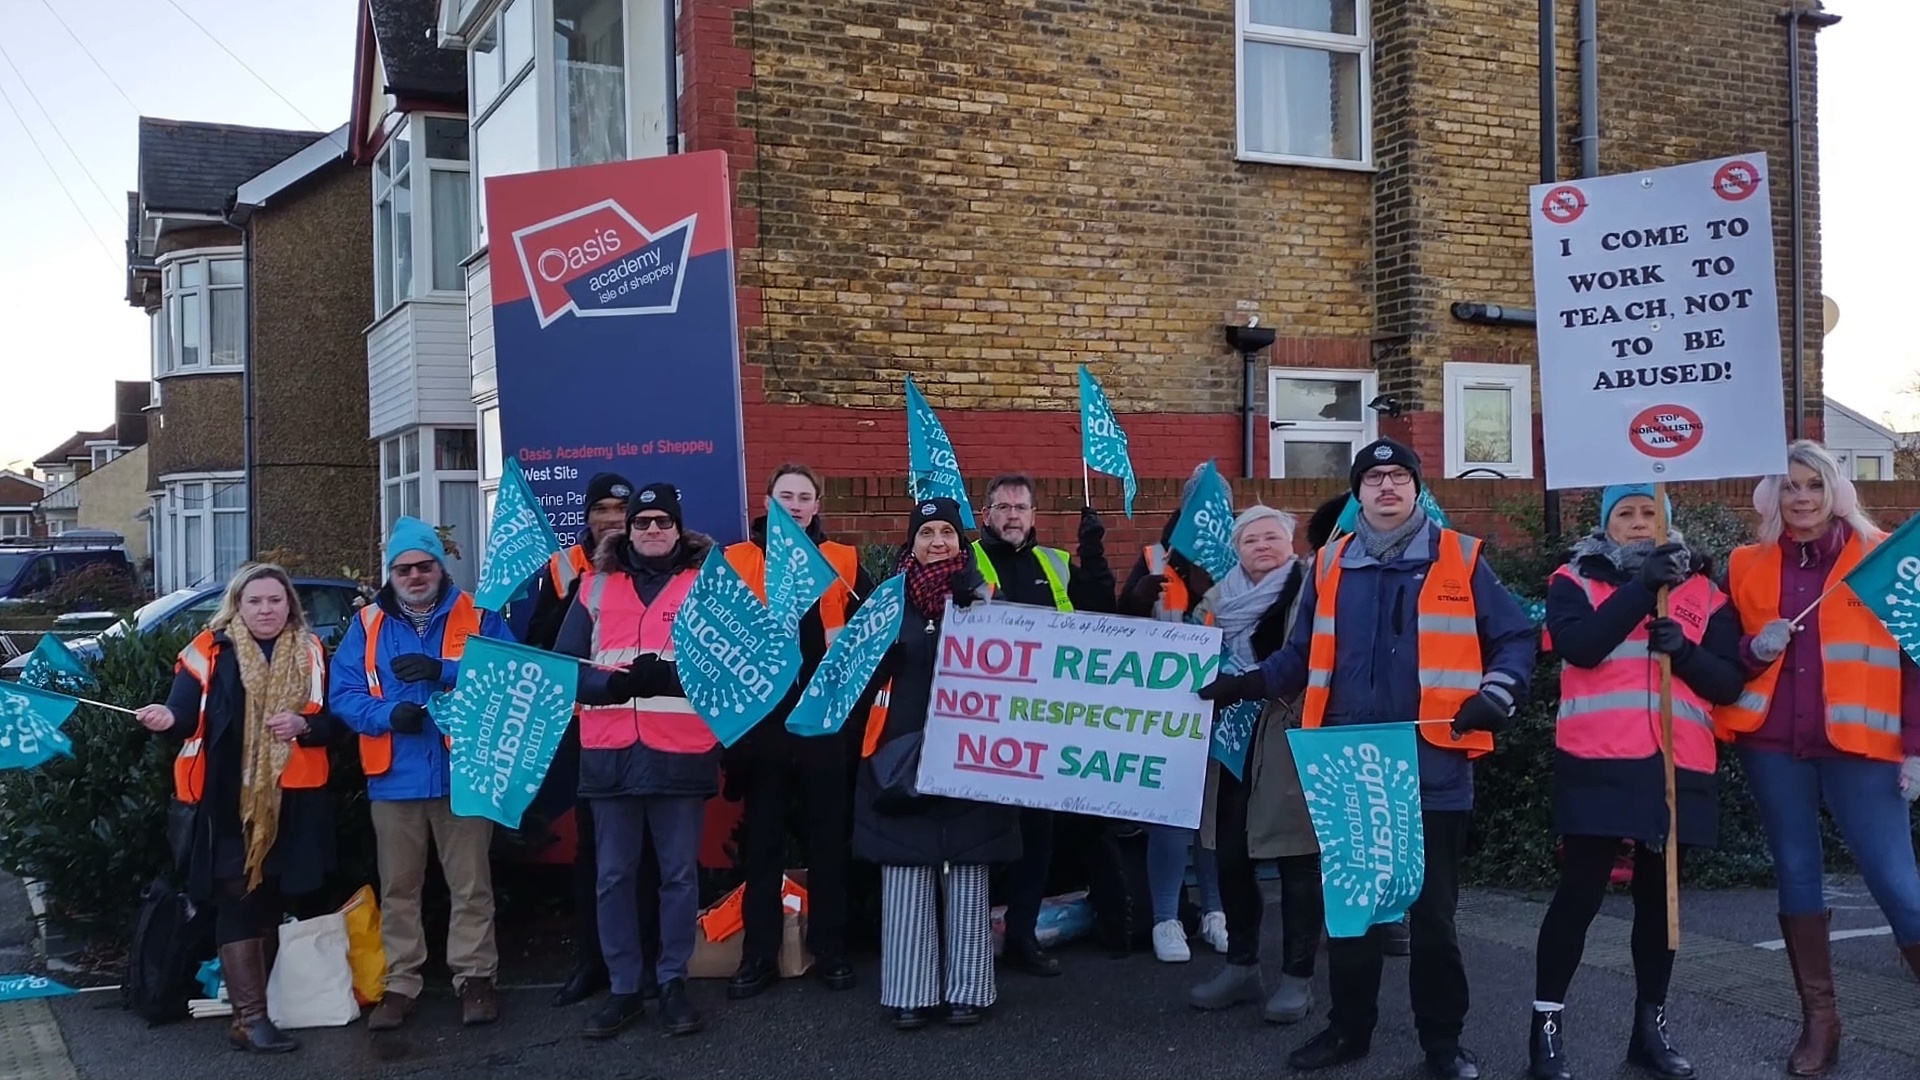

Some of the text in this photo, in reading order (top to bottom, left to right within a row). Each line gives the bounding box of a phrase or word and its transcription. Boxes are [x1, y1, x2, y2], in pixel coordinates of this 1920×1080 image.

[537, 228, 622, 282] Oasis
[1559, 217, 1750, 257] I COME TO
[589, 246, 662, 292] academy
[598, 261, 675, 305] isle of sheppey
[1568, 256, 1735, 293] WORK TO
[1559, 289, 1753, 328] TEACH, NOT
[1612, 328, 1726, 358] TO BE
[1592, 361, 1733, 391] ABUSED!
[1631, 422, 1704, 435] NORMALISING
[1653, 413, 1680, 423] STOP
[519, 439, 713, 463] Oasis Academy Isle of Sheppey
[1650, 434, 1685, 445] ABUSE
[519, 465, 579, 482] West Site
[534, 493, 564, 507] arine
[701, 594, 767, 655] national
[681, 597, 775, 704] ducation
[681, 636, 722, 685] union
[942, 636, 1220, 693] NOT READY
[935, 688, 1002, 718] NOT
[957, 733, 1048, 774] NOT
